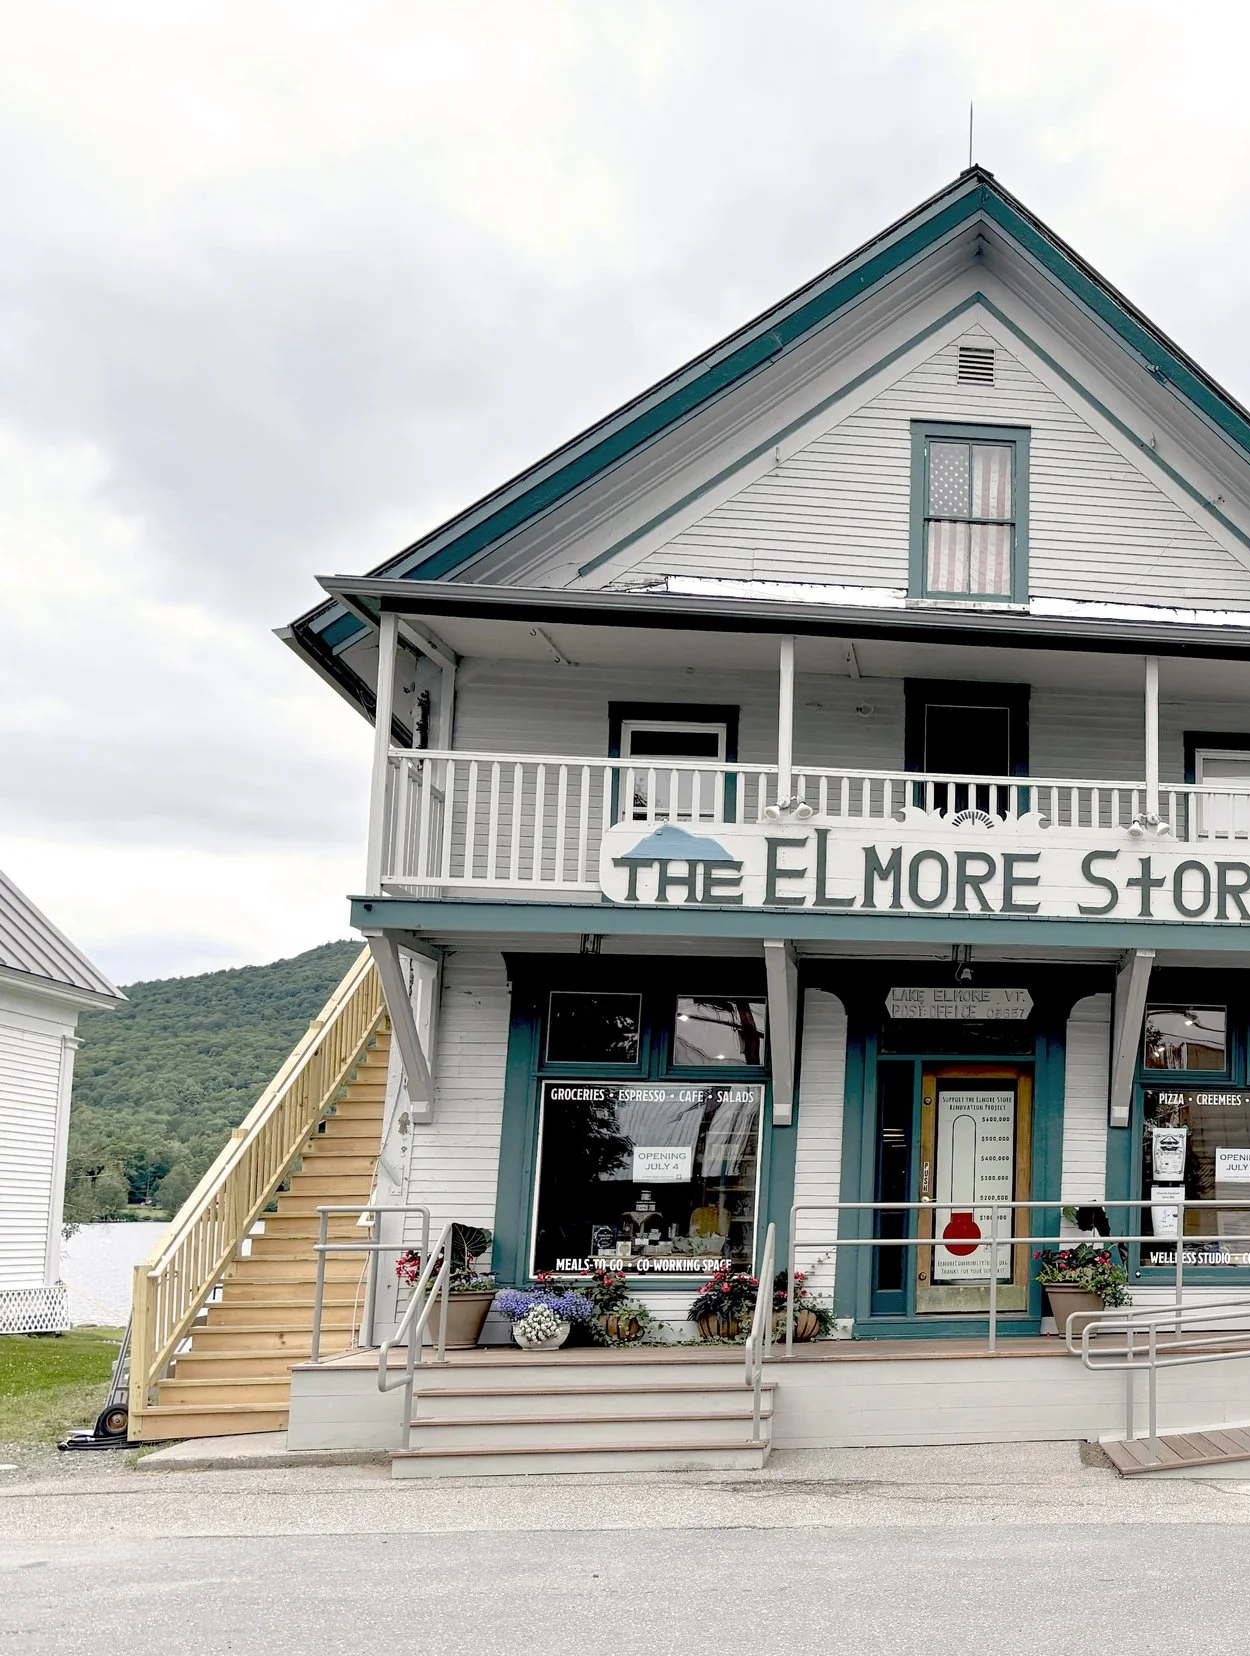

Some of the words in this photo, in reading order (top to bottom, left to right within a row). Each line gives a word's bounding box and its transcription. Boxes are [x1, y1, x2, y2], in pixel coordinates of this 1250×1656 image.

[612, 857, 744, 905] THE
[763, 828, 1041, 914] ELMORE
[892, 988, 926, 1002] LAKE
[933, 989, 991, 1003] ELMORE
[551, 1088, 605, 1101] GROCERIES
[618, 1089, 666, 1101] ESPRESSO
[679, 1090, 704, 1103] CAFE
[716, 1091, 754, 1103] SALADS
[1159, 1093, 1184, 1105] PIZZA
[1197, 1093, 1242, 1106] CREEMEES
[638, 1152, 687, 1160] OPENING
[556, 1258, 624, 1271] MEALS-TO-GO
[636, 1258, 700, 1271] CO-WORKING
[1197, 1252, 1231, 1265] STUDIO
